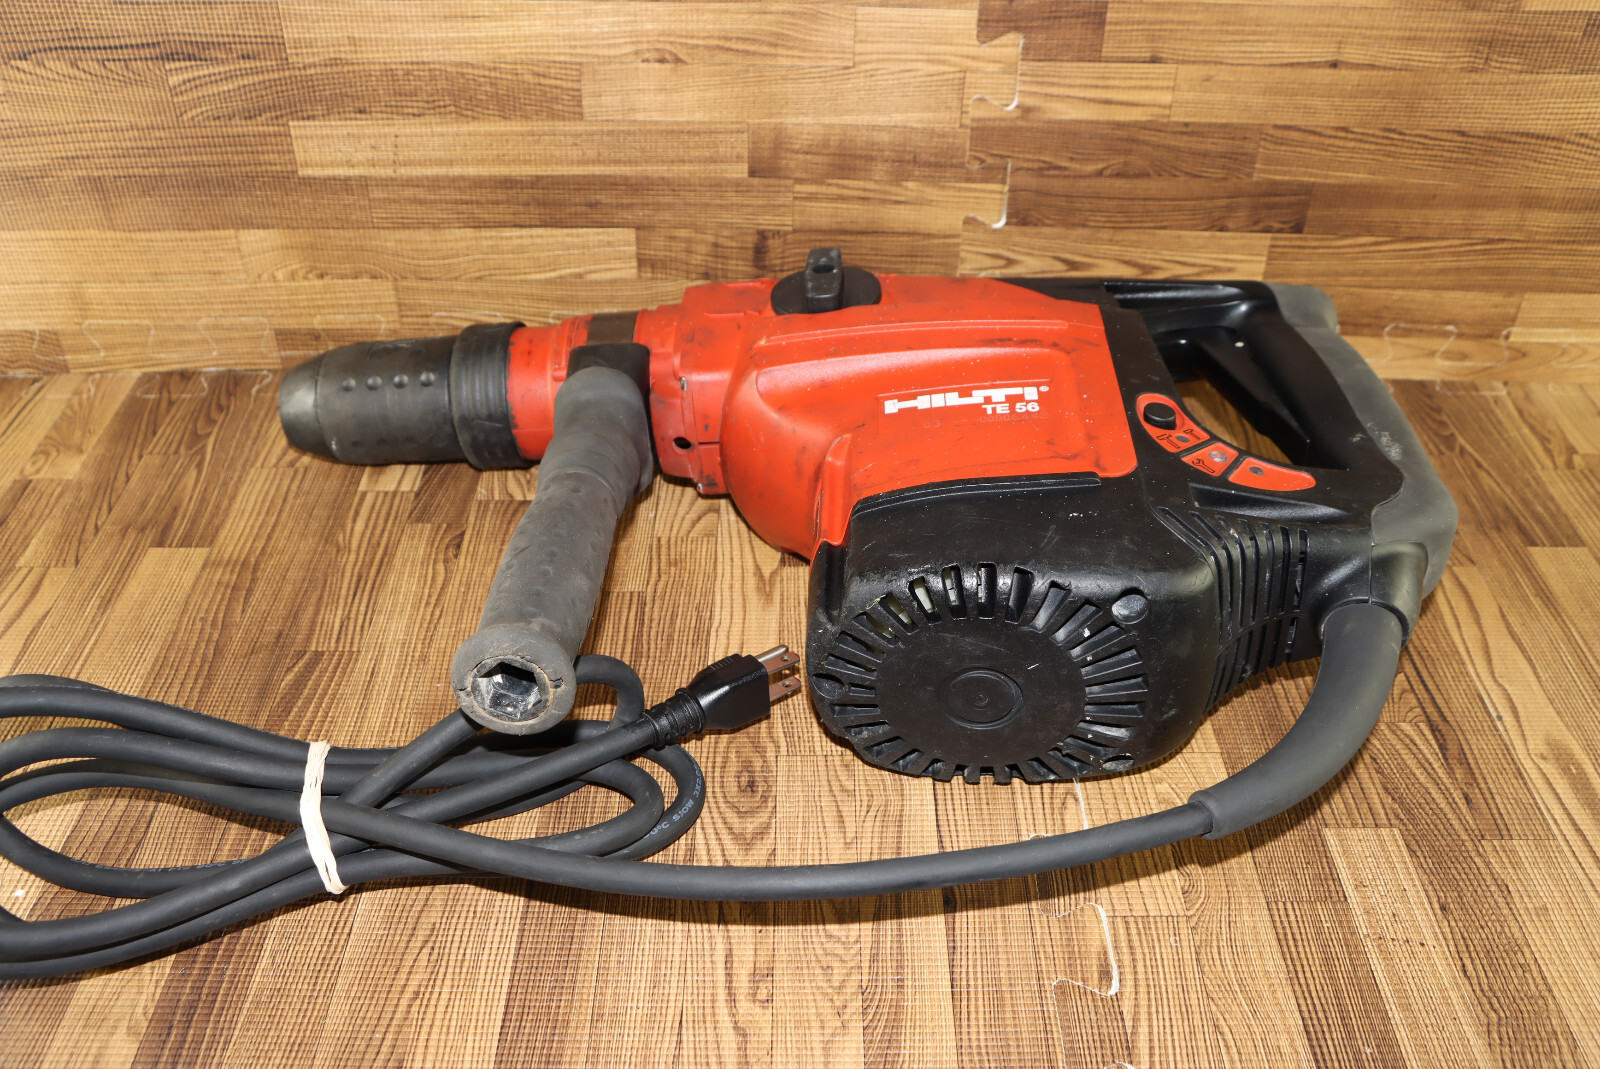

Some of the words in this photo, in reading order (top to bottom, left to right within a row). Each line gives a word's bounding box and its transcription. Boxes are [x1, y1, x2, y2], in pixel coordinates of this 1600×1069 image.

[884, 386, 1039, 415] HILTI
[981, 403, 1010, 415] TE
[1015, 402, 1041, 413] 56
[643, 821, 670, 839] 0°C
[672, 798, 695, 822] SJOW
